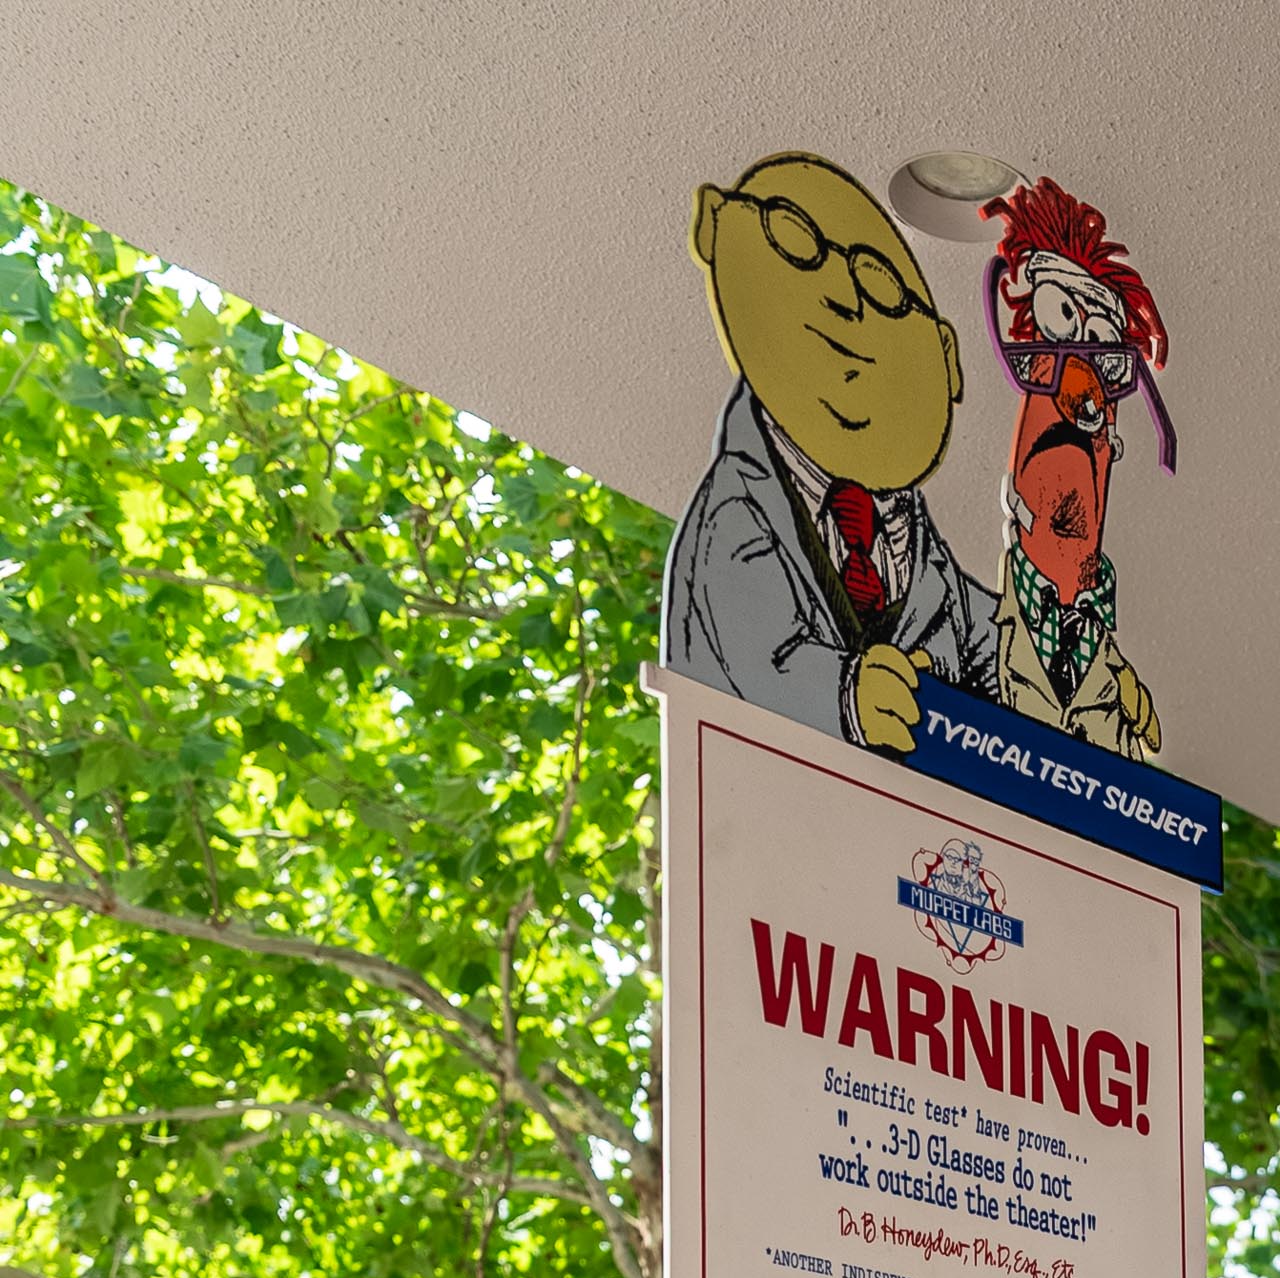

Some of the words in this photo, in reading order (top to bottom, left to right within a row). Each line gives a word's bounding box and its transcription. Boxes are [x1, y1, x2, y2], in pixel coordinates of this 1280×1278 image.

[927, 710, 1034, 777] TYPICAL
[1039, 757, 1101, 800] TEST
[1103, 785, 1208, 845] SUBJECT
[911, 886, 970, 923] MUPPET
[974, 909, 1012, 939] LABS
[750, 917, 1150, 1137] WARNING!
[824, 1067, 915, 1115] Scientific
[976, 1109, 1010, 1142] have
[1018, 1127, 1088, 1164] proven...
[819, 1153, 870, 1188] work
[877, 1168, 958, 1210] outside
[965, 1184, 999, 1221] the
[1006, 1195, 1096, 1242] theater!"
[927, 1133, 1005, 1183] Glasses
[1012, 1157, 1034, 1192] do
[1040, 1172, 1072, 1201] not
[881, 1216, 970, 1265] Honeydew,
